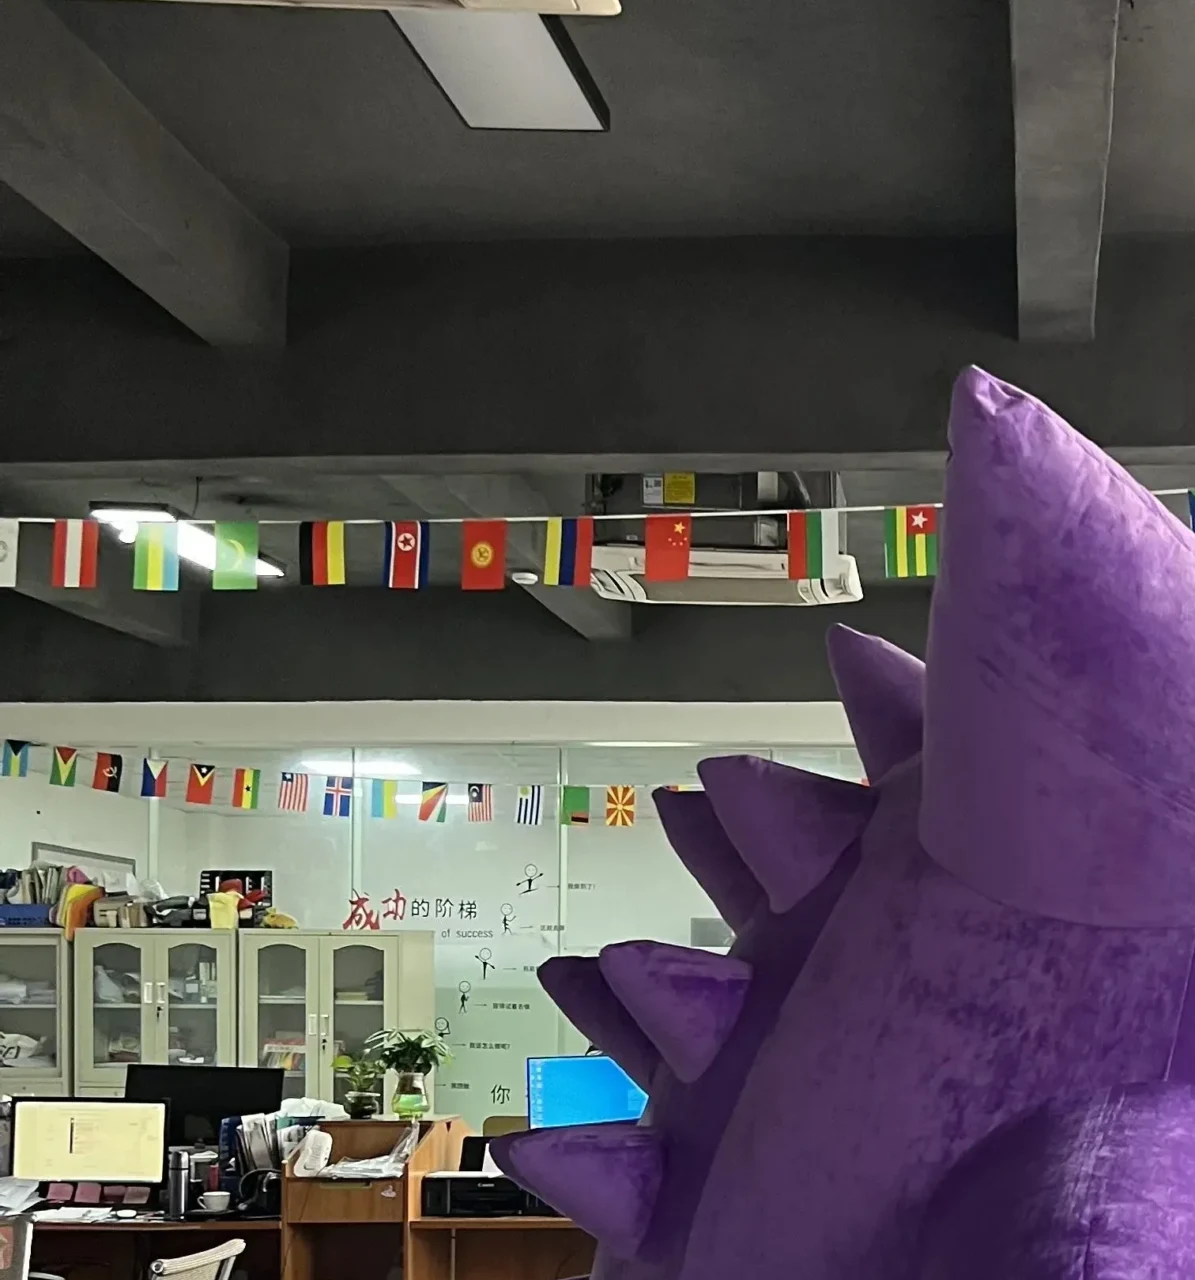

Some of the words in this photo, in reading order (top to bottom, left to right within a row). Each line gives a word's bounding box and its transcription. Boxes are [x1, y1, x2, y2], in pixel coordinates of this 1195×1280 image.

[343, 888, 478, 930] 成功的阶梯
[441, 928, 451, 938] of
[456, 929, 494, 938] success
[490, 1084, 511, 1105] 你
